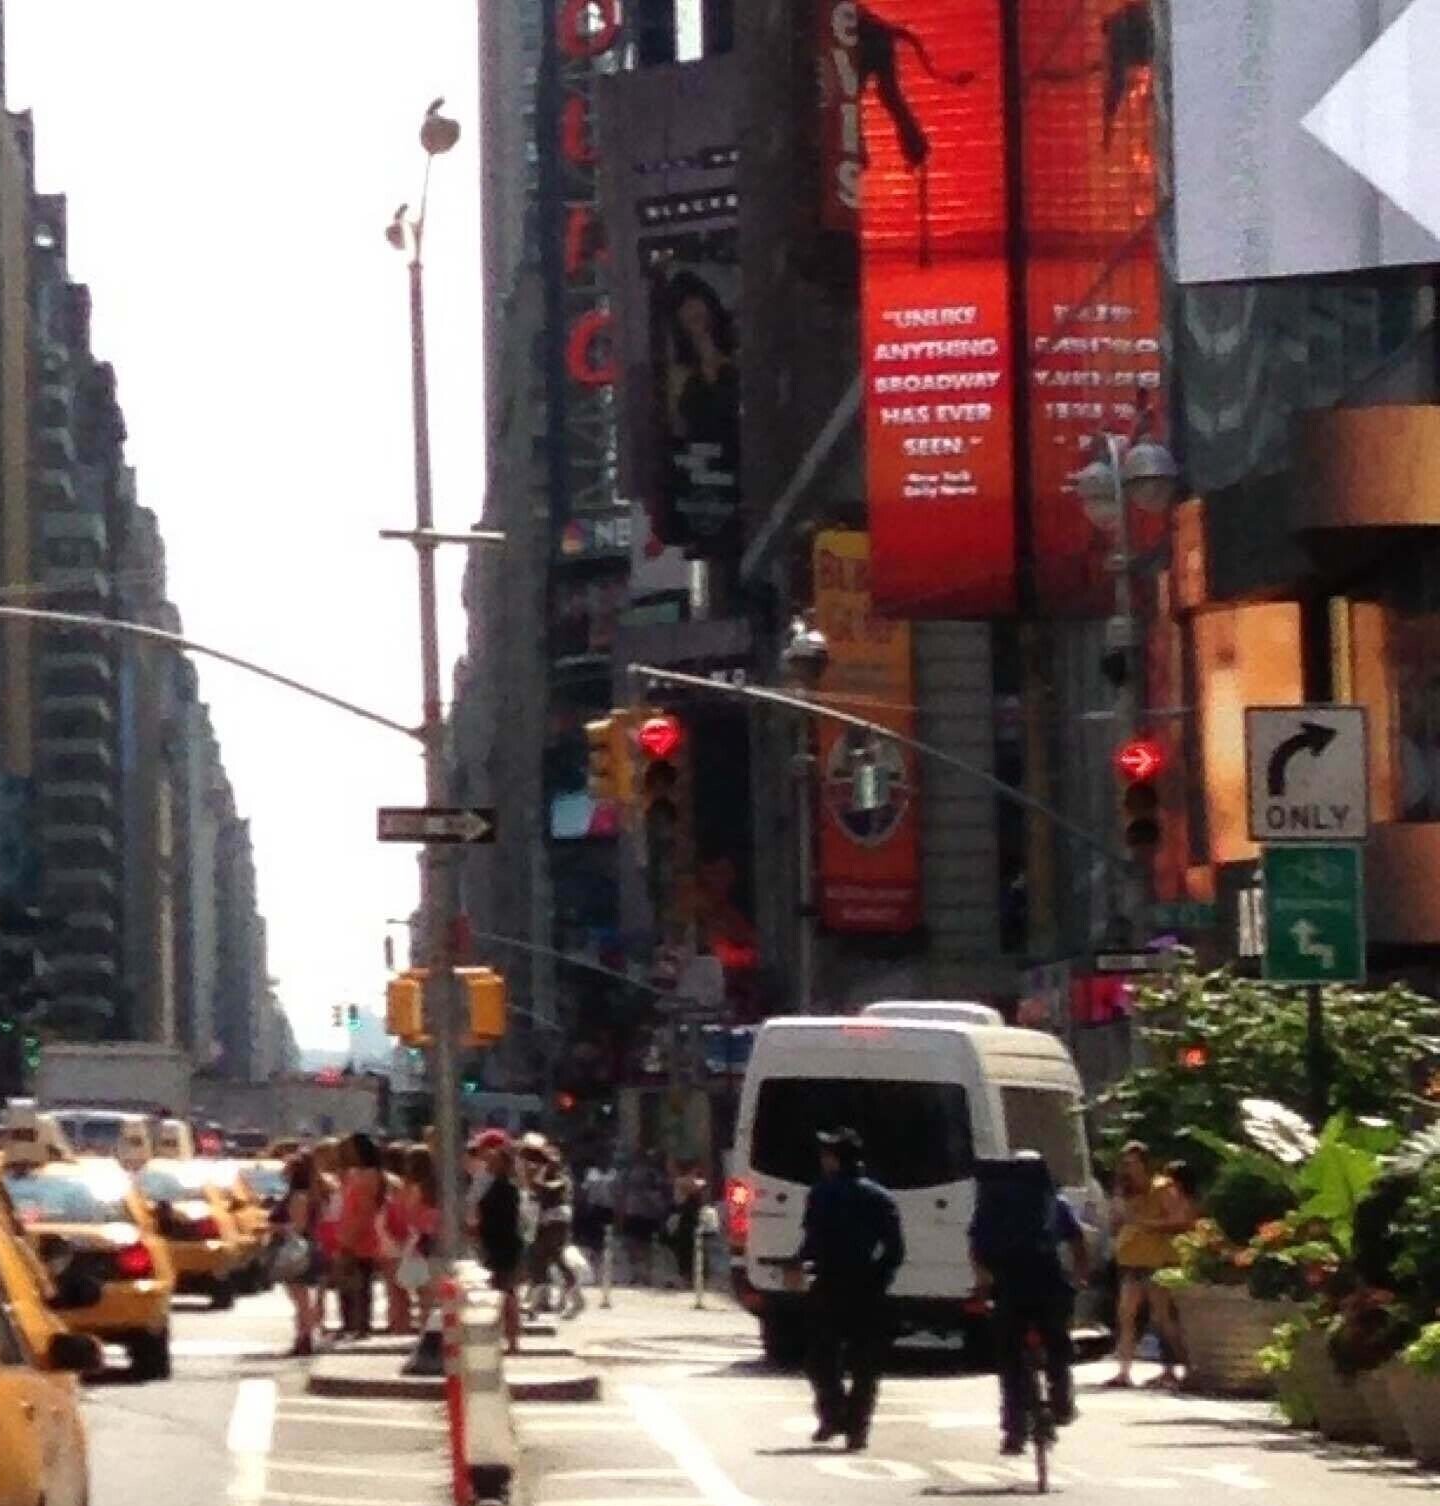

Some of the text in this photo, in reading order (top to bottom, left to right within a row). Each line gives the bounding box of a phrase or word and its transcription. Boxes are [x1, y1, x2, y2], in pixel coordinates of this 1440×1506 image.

[874, 337, 999, 361] ANYTHING
[874, 371, 1001, 394] BROADWAY
[880, 404, 930, 425] HAS
[1265, 804, 1350, 831] ONLY
